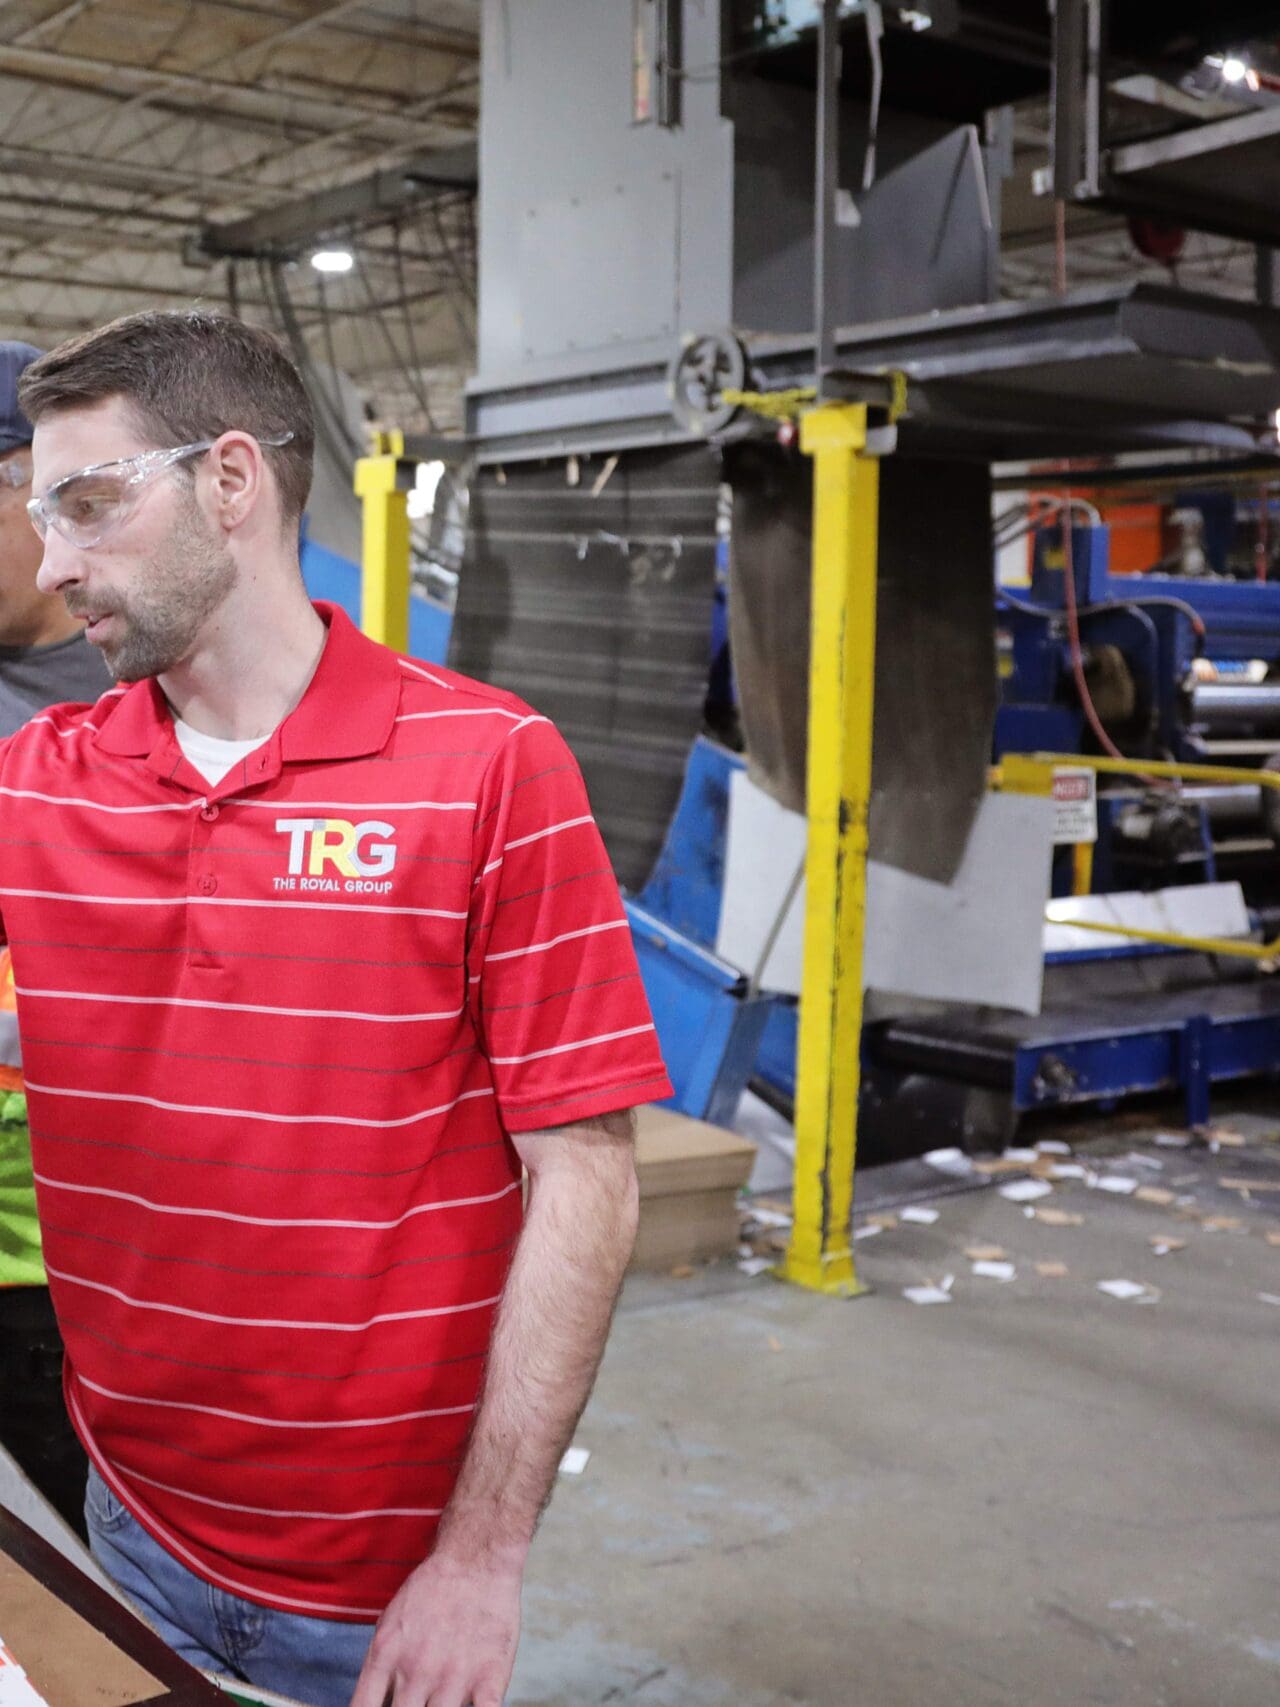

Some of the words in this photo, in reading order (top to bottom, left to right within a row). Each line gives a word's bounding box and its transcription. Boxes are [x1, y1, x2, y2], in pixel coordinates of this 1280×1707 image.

[275, 819, 397, 877] TRG
[273, 877, 296, 891] THE
[300, 878, 341, 892] ROYAL
[344, 880, 394, 894] GROUP
